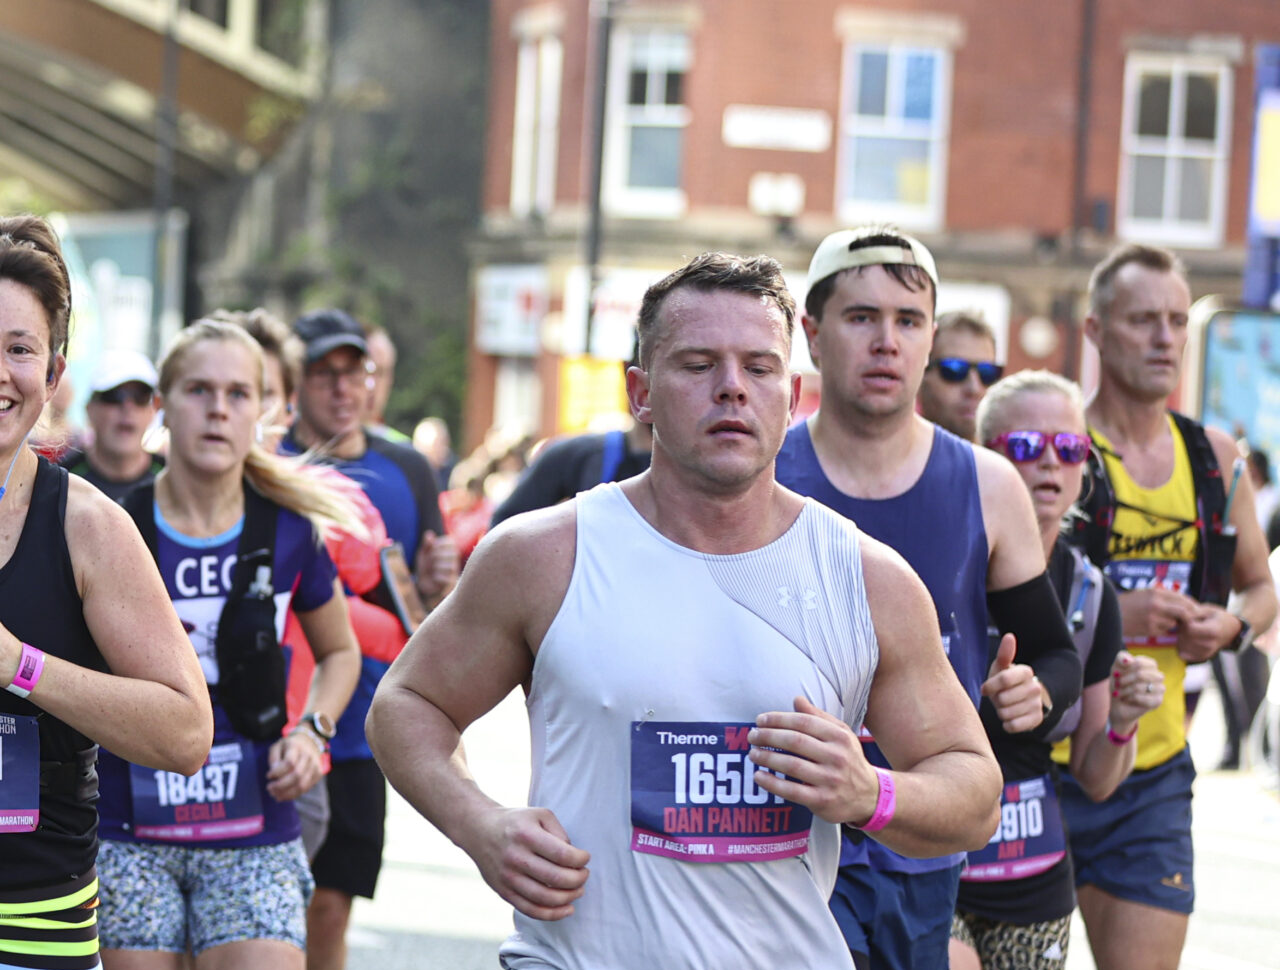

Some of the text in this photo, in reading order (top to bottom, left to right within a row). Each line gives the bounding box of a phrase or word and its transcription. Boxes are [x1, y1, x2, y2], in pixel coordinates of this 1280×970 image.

[656, 731, 718, 746] Therme
[153, 762, 239, 807] 18437
[663, 806, 793, 834] DAN PANNETT
[638, 833, 663, 849] START
